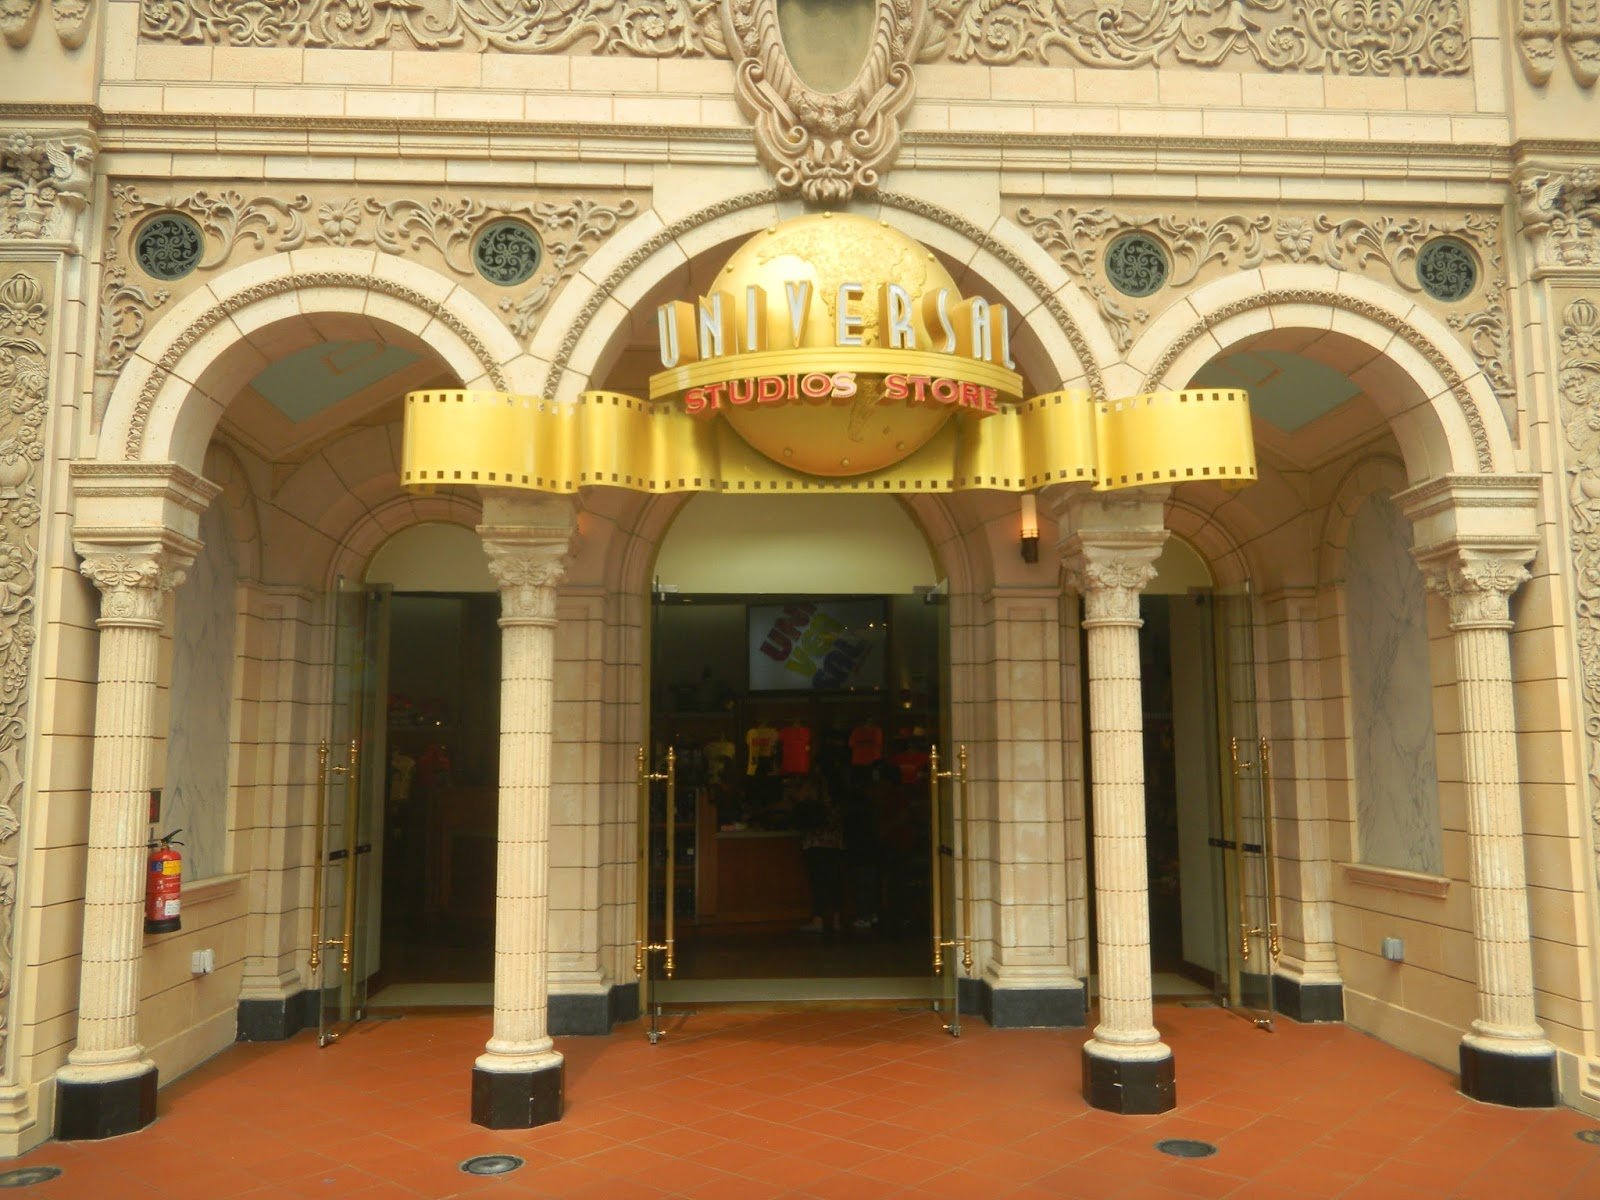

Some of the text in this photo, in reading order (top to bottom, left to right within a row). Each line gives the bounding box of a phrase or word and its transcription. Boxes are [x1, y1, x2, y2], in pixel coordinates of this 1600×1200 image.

[658, 281, 1015, 370] UNIVERSAL
[685, 373, 999, 413] STUDIOS STORE
